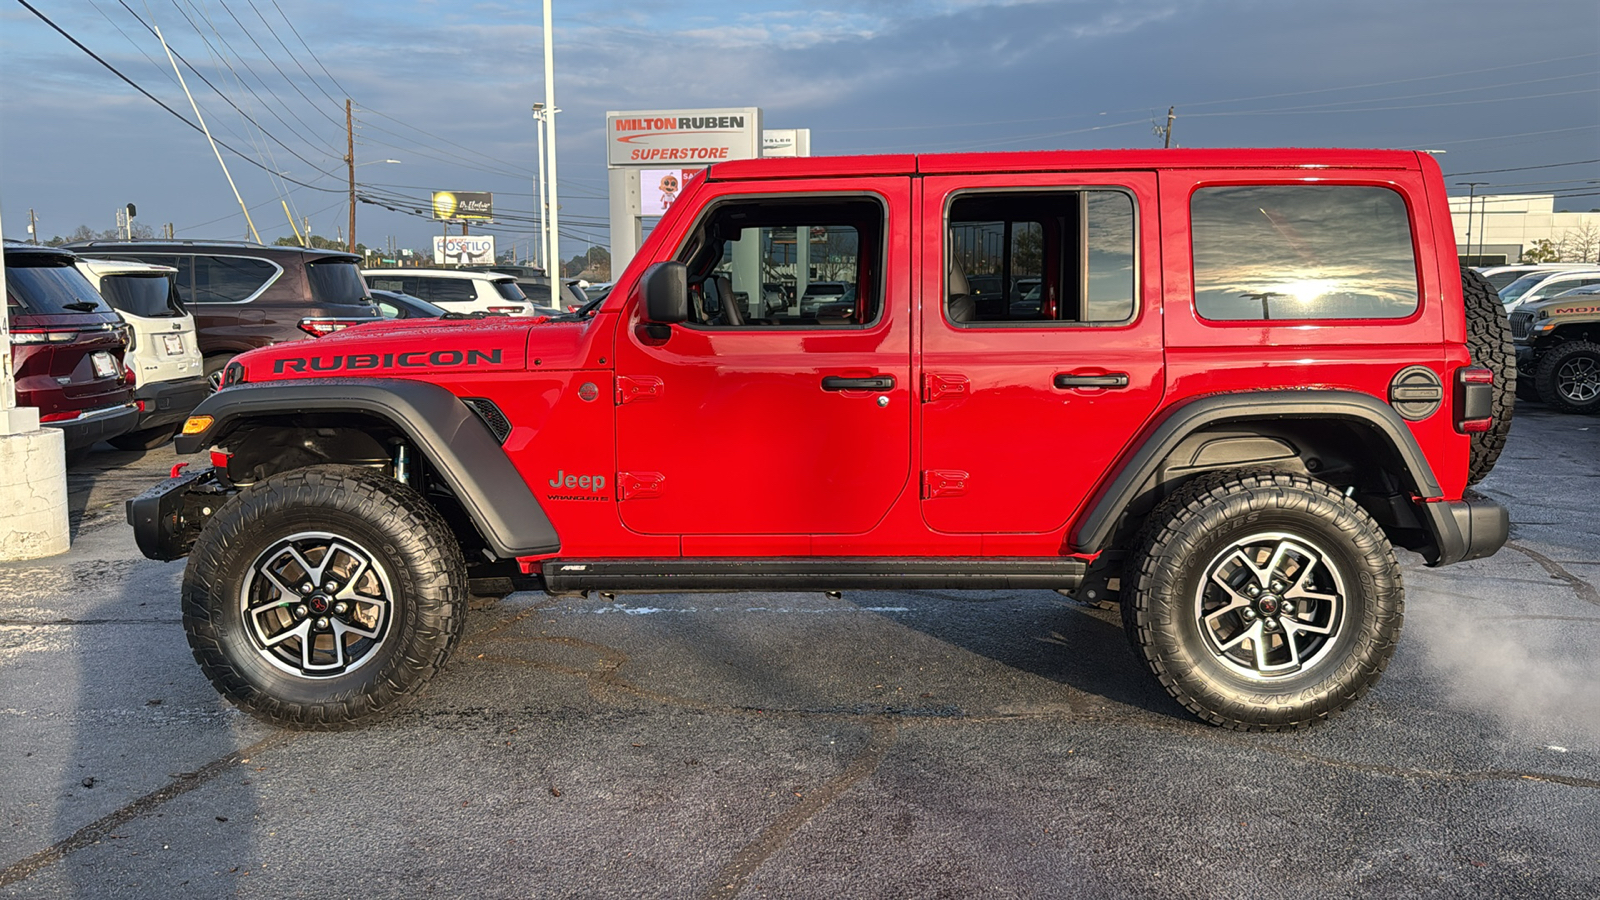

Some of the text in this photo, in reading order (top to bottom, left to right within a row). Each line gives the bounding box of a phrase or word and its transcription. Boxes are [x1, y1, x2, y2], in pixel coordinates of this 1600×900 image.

[615, 116, 744, 131] MILTON RUBEN
[630, 147, 729, 161] SUPERSTORE
[273, 349, 503, 373] RUBICON
[548, 470, 605, 492] Jeep
[1198, 511, 1261, 552] TIRES
